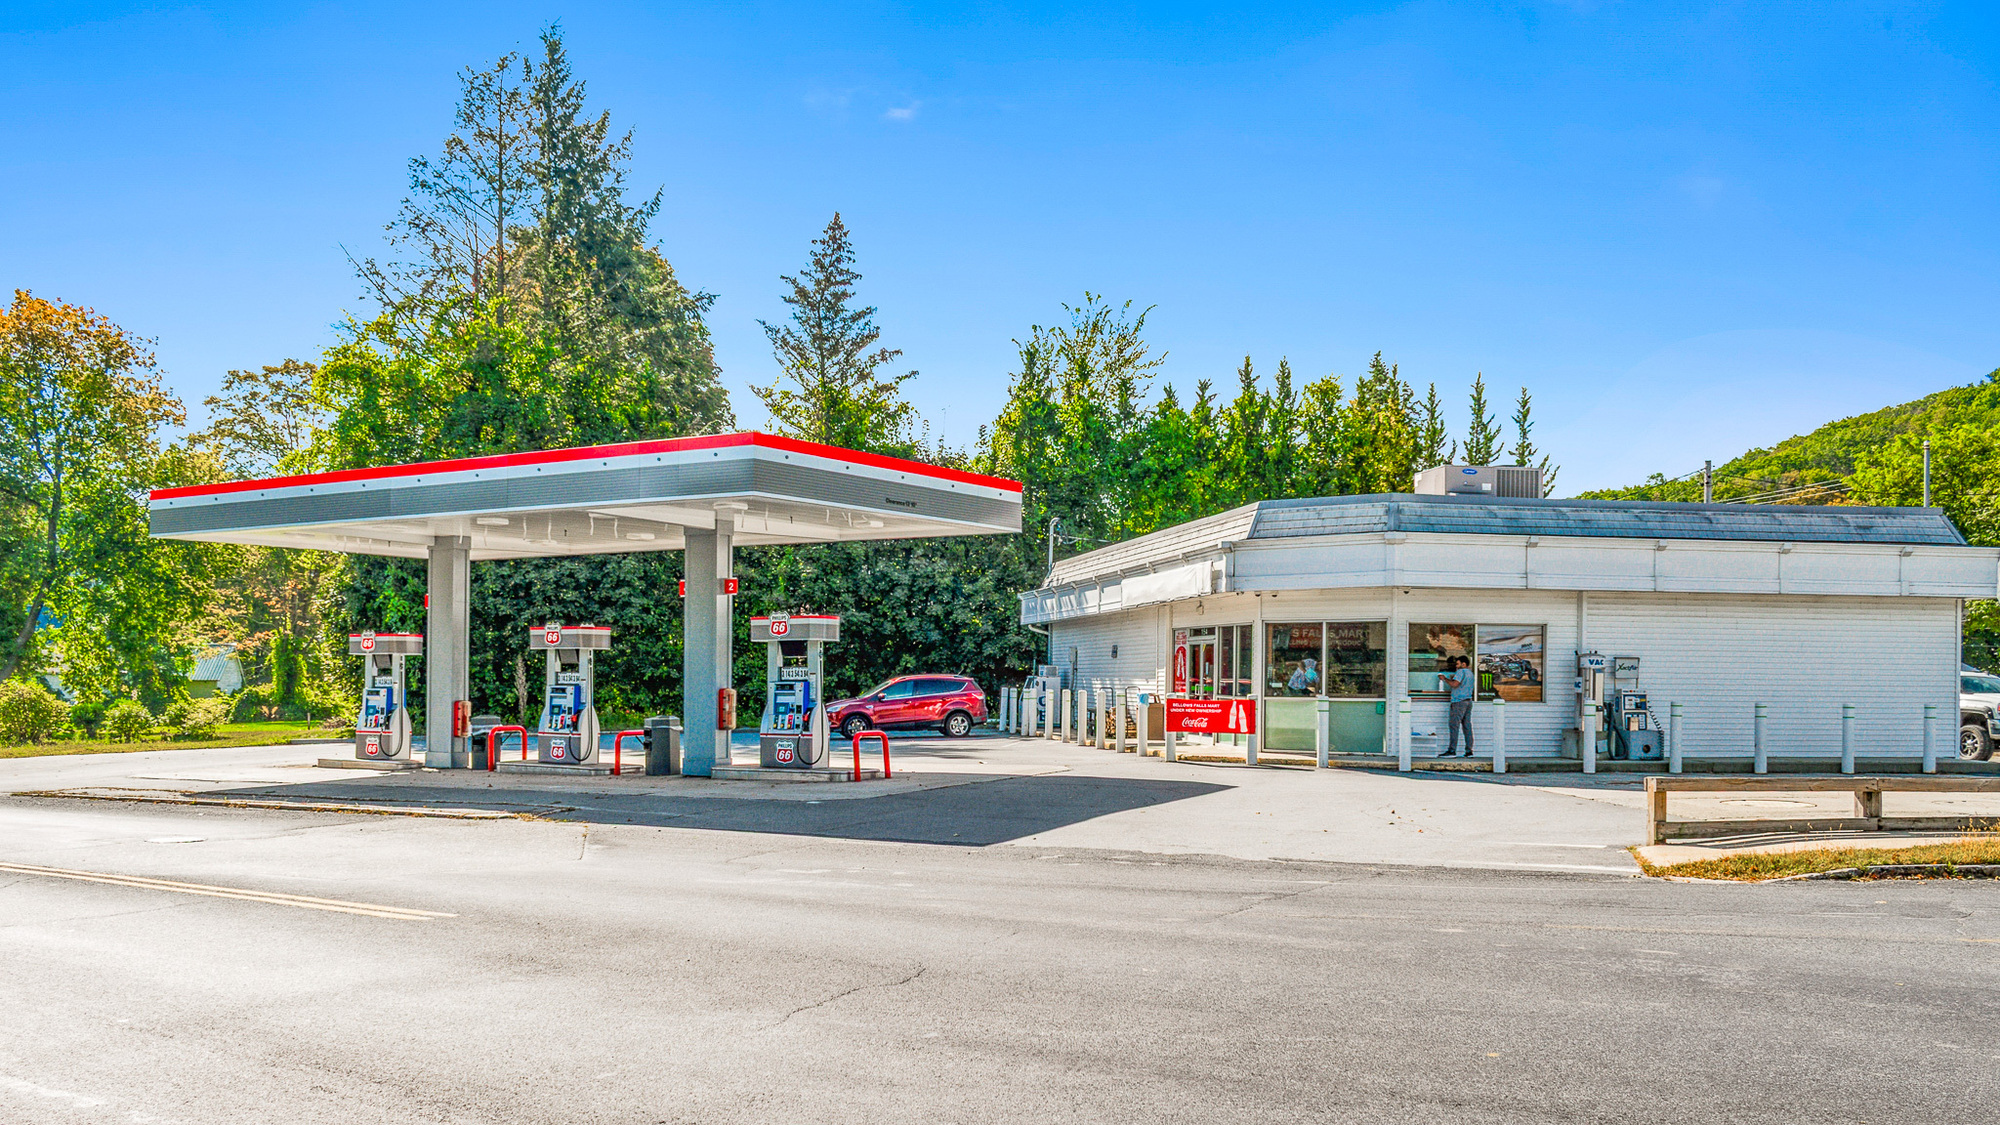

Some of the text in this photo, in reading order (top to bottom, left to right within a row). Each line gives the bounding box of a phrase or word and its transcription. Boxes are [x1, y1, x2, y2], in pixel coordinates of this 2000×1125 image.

[728, 582, 734, 591] 2
[773, 622, 786, 633] 66
[547, 632, 558, 642] 66
[363, 639, 373, 648] 66
[368, 744, 377, 753] 66
[553, 747, 563, 757] 66
[779, 750, 792, 760] 66
